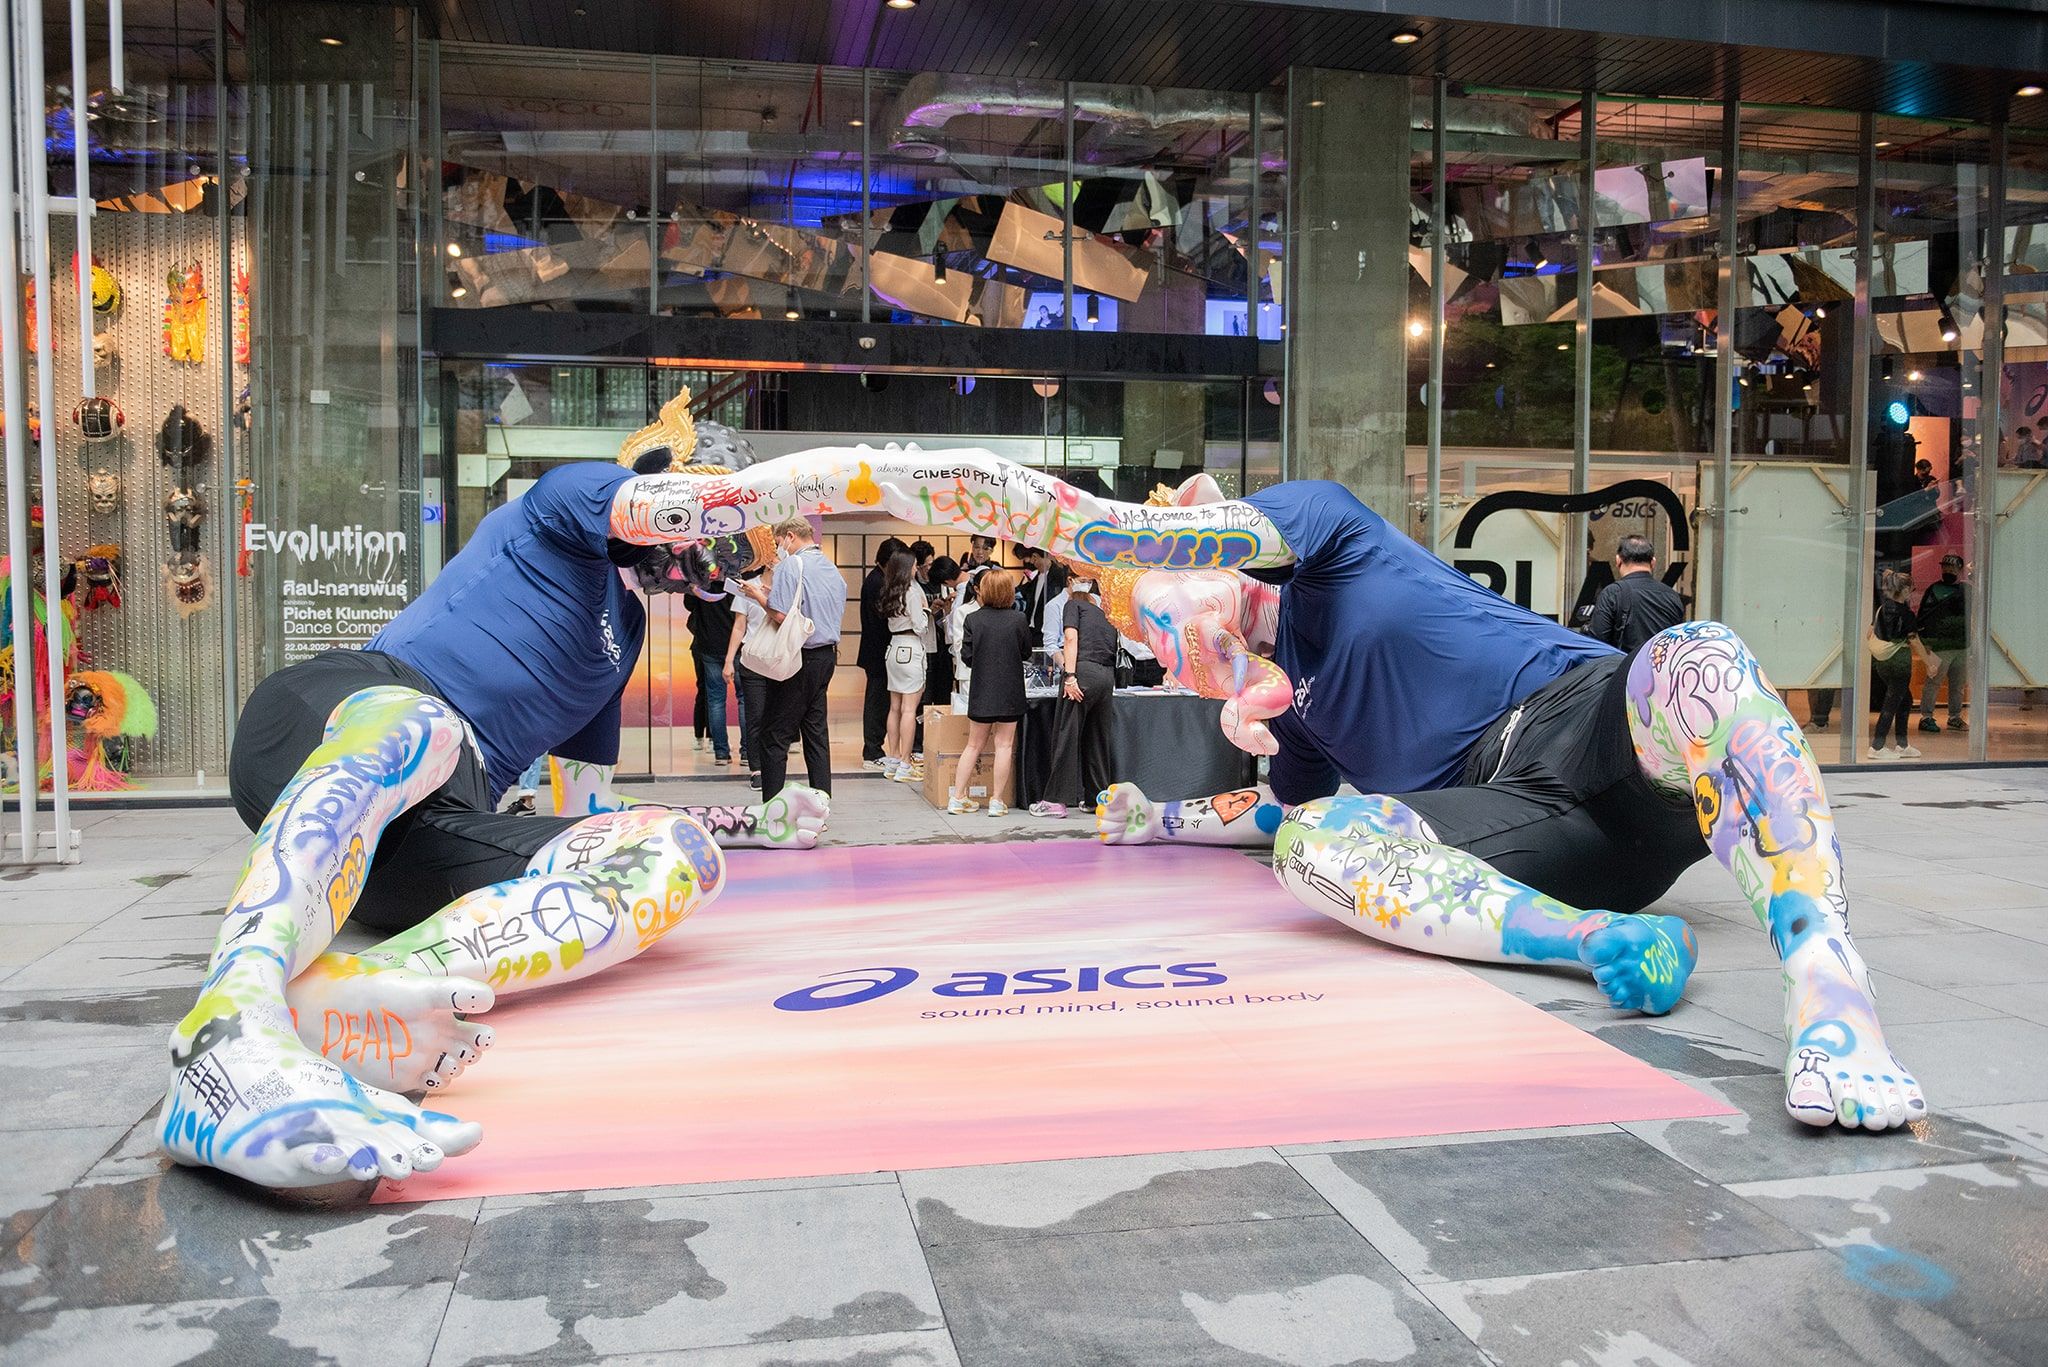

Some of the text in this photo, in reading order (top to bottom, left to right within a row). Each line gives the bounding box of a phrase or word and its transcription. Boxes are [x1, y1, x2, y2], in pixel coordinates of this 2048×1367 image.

[912, 467, 1009, 488] CINESUPPLY
[1200, 507, 1217, 520] to
[1612, 502, 1658, 518] asics
[244, 523, 407, 566] Evolution
[283, 607, 402, 620] Pichet Klunchu
[284, 621, 332, 634] Dance
[931, 961, 1228, 998] asics
[919, 991, 1325, 1019] sound mind, sound body
[320, 1005, 414, 1069] DEAD
